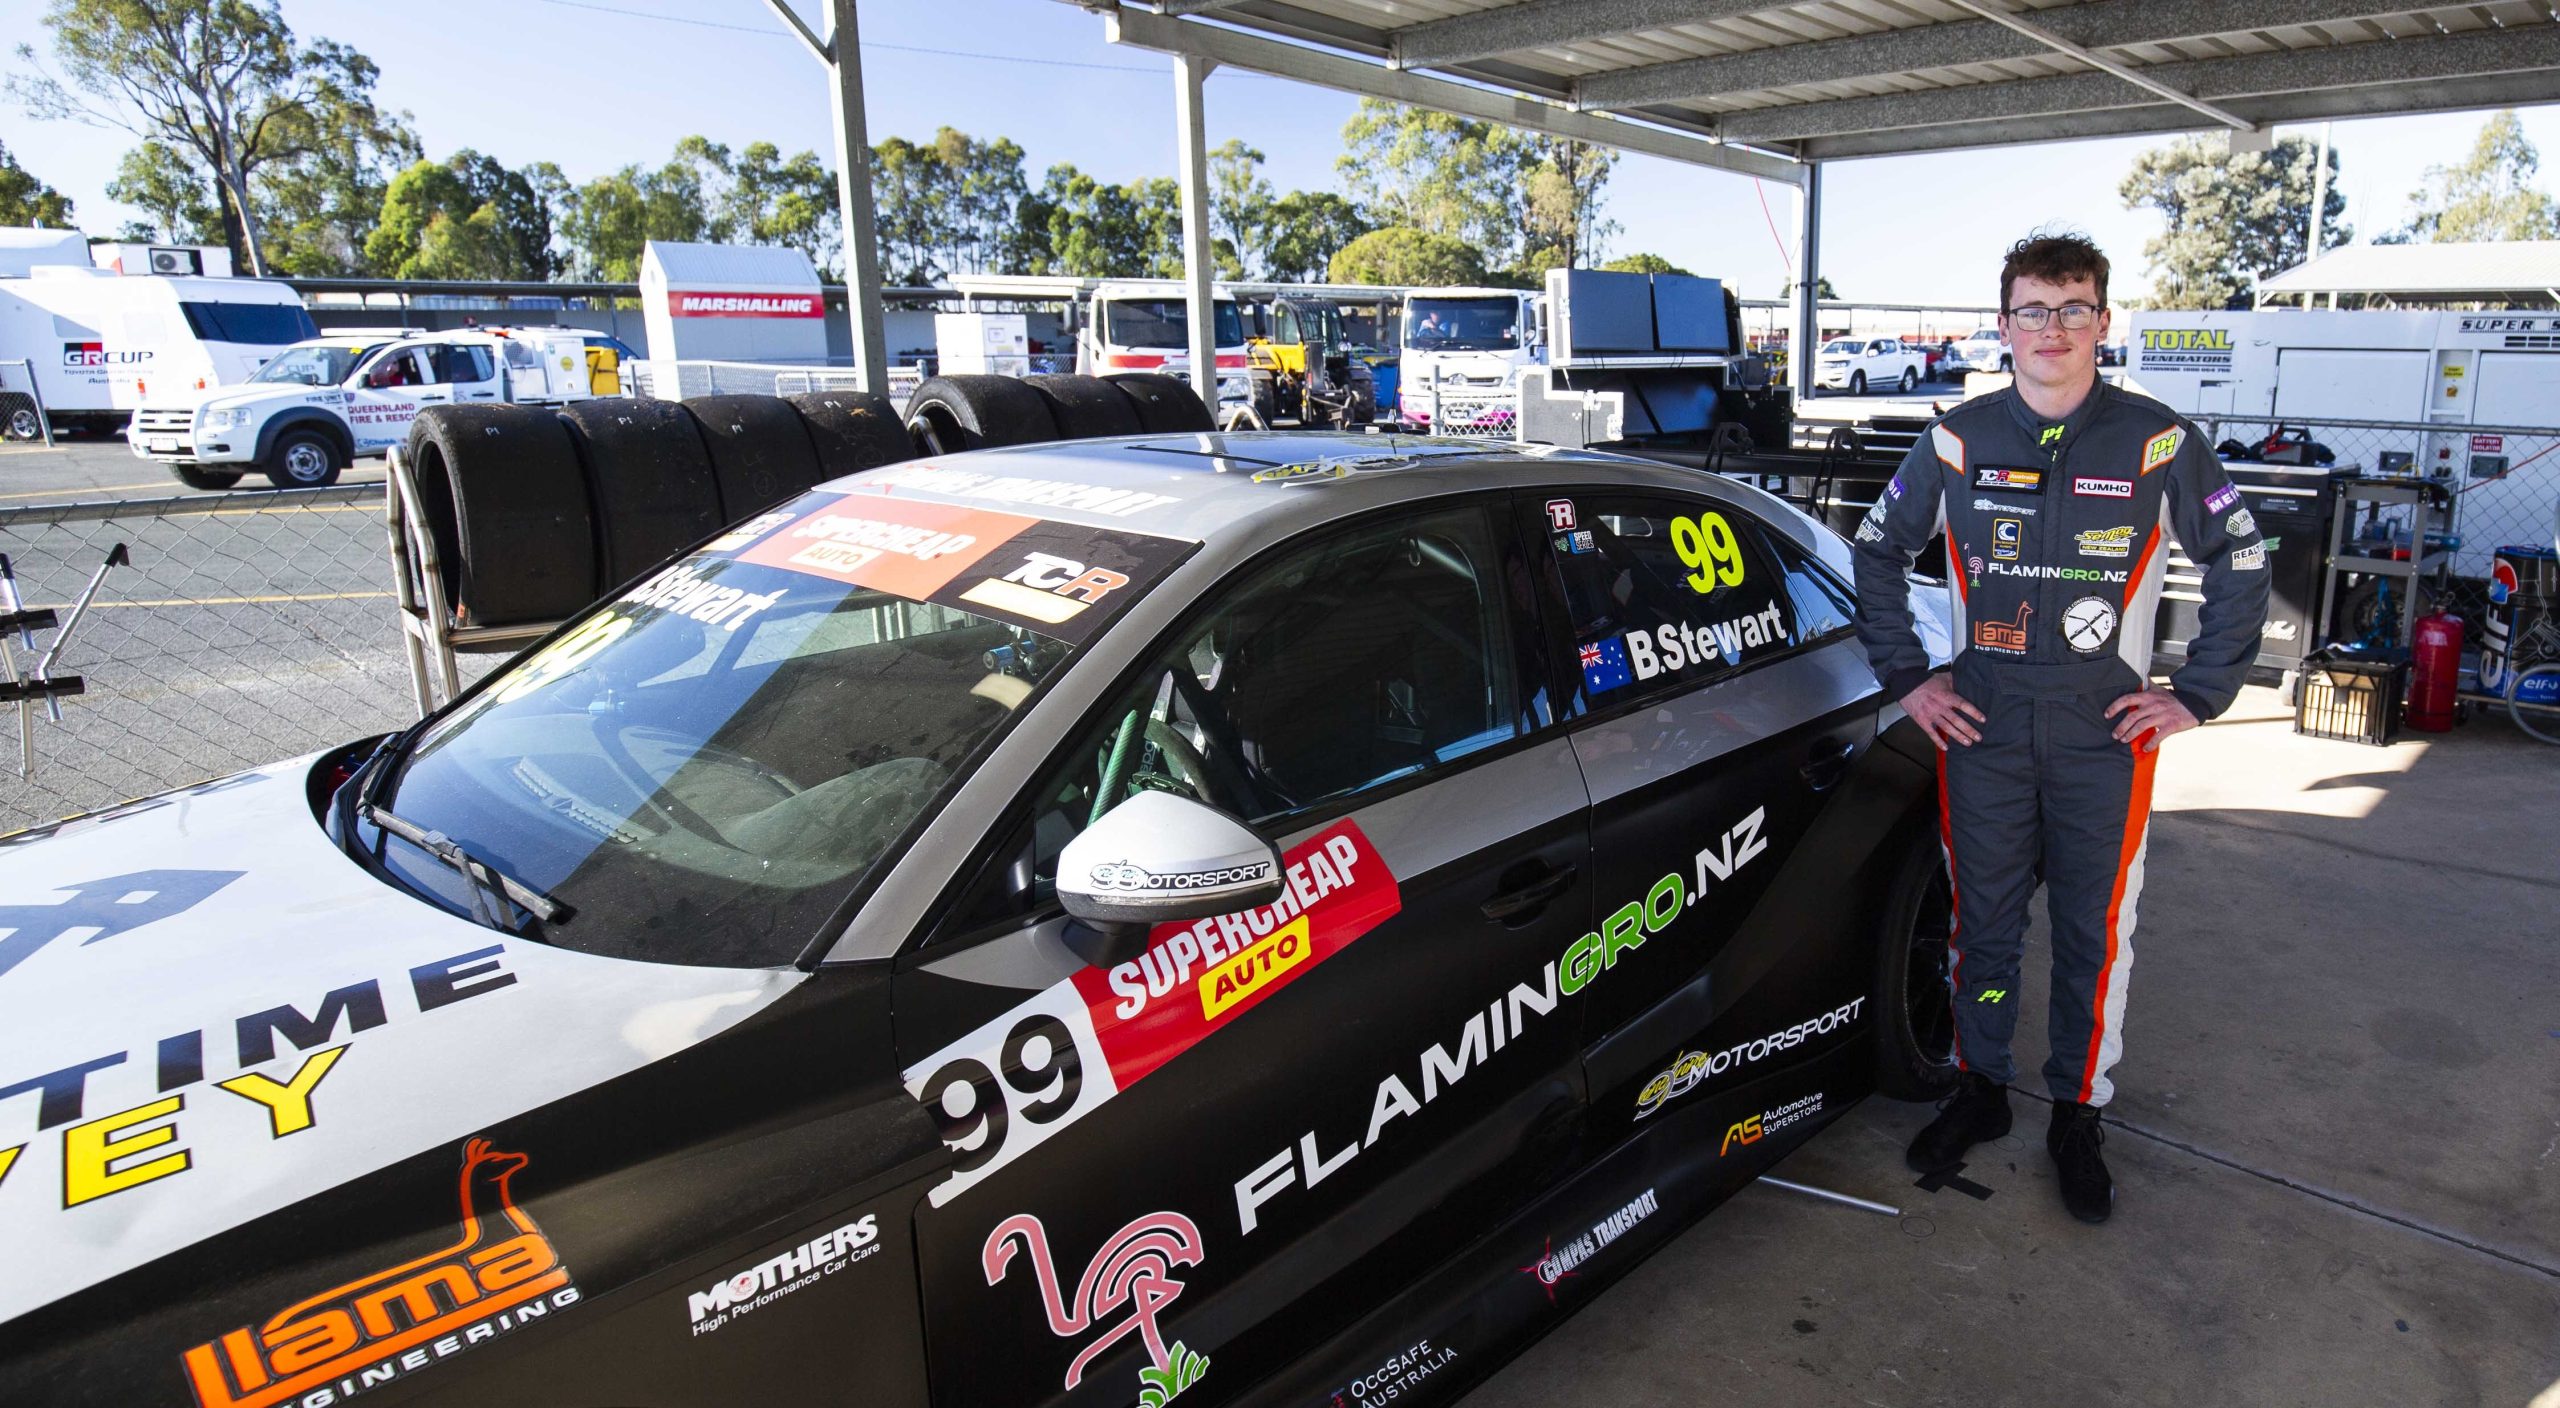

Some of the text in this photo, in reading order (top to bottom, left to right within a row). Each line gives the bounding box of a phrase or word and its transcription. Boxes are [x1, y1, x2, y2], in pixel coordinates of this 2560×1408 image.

[682, 297, 812, 313] MARSHALLING
[2461, 319, 2534, 331] SUPER
[2141, 329, 2235, 351] TOTAL
[64, 350, 154, 366] GR CUP
[2141, 354, 2231, 364] GENERATORS
[348, 403, 415, 415] QUEENSLAND
[350, 415, 372, 424] FIRE
[375, 415, 382, 423] &
[1980, 469, 2010, 482] TCR
[2077, 482, 2130, 493] KUMHO
[791, 513, 978, 561] SUPERCHEAP
[1574, 531, 1592, 541] SPEED
[1575, 540, 1594, 550] SERIES
[806, 545, 866, 567] AUTO
[1670, 512, 1745, 594] 99
[1001, 551, 1130, 605] TCR
[1988, 562, 2128, 583] FLAMINGRO.NZ
[1626, 599, 1787, 681] B.Stewart
[1975, 644, 2027, 656] ENGINEERING
[1215, 934, 1298, 1004] AUTO
[1233, 805, 1768, 1236] FLAMINGRO.NZ
[1687, 996, 1866, 1087] MOTORSPORT
[918, 1013, 1083, 1175] 99
[1762, 1092, 1824, 1124] Automotive
[1763, 1101, 1823, 1136] SUPERSTORE
[1543, 1187, 1659, 1282] COMPAS TRANSPORT
[688, 1213, 879, 1324] MOTHERS
[692, 1242, 881, 1337] High Performance Car Care
[1360, 1347, 1458, 1408] AUSTRALIA
